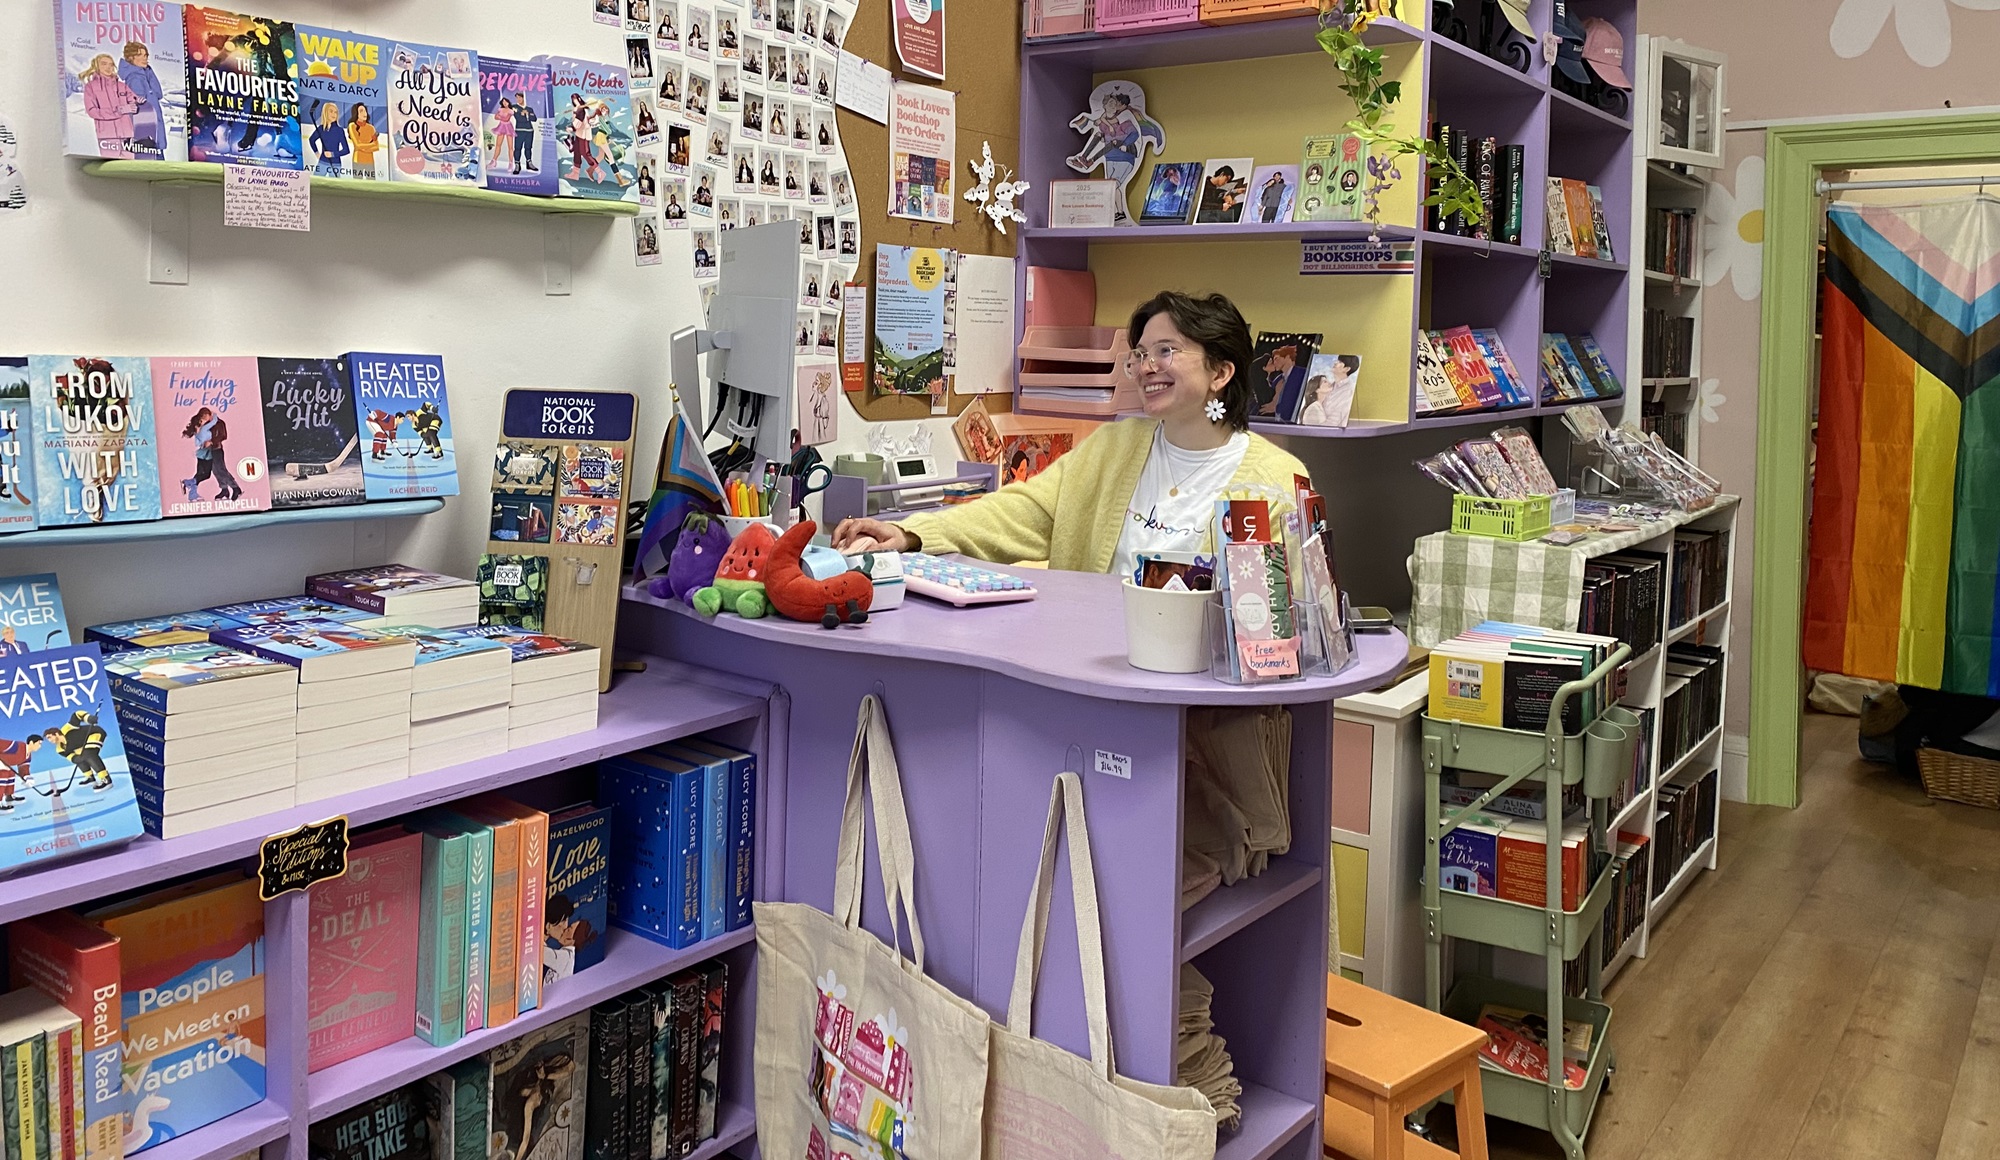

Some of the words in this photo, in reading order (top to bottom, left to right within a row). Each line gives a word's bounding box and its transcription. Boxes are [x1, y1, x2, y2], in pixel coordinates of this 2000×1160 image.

[76, 1, 165, 24] MELTING
[95, 24, 158, 44] POINT
[299, 33, 379, 65] WAKE
[235, 57, 258, 73] THE
[340, 62, 377, 86] UP
[195, 67, 299, 103] FAVOURITES
[299, 78, 324, 91] NAT
[327, 82, 336, 93] &
[339, 84, 379, 98] DARCY
[395, 69, 426, 91] All
[427, 71, 472, 104] You
[478, 72, 549, 93] REVOLVE
[585, 88, 627, 96] RELATIONSHIP
[197, 92, 244, 110] LAYNE
[253, 98, 299, 117] FARGO
[397, 94, 453, 123] Need
[456, 110, 471, 128] is
[896, 94, 919, 110] Book
[921, 99, 950, 116] Lovers
[896, 107, 940, 130] Bookshop
[402, 120, 475, 153] Gloves
[896, 121, 945, 142] Pre-Orders
[100, 140, 119, 150] Cici
[121, 141, 162, 155] Williams
[1481, 141, 1492, 161] KING
[229, 166, 245, 175] THE
[251, 168, 300, 180] FAVOURITES
[326, 166, 376, 178] COCHRANE
[1481, 164, 1492, 177] OF
[247, 177, 268, 186] LAYNE
[270, 179, 289, 187] FARGO
[494, 177, 508, 185] BAL
[510, 178, 541, 187] KHABRA
[878, 252, 889, 261] Shop
[1303, 251, 1393, 263] BOOKSHOPS
[878, 276, 910, 286] Independent.
[358, 361, 440, 382] HEATED
[50, 371, 134, 399] FROM
[169, 371, 237, 397] Finding
[360, 381, 441, 399] RIVALRY
[174, 392, 197, 407] Her
[202, 391, 237, 413] Edge
[266, 380, 345, 411] Lucky
[543, 396, 597, 407] NATIONAL
[45, 404, 142, 434] LUKOV
[286, 403, 331, 431] Hit
[541, 405, 596, 425] BOOK
[541, 422, 595, 435] tokens
[44, 439, 98, 449] MARIANA
[103, 438, 149, 448] ZAPATA
[57, 450, 138, 480] WITH
[580, 465, 604, 474] BOOK
[64, 484, 140, 515] LOVE
[274, 489, 319, 500] HANNAH
[323, 488, 360, 498] COWAN
[389, 487, 418, 495] RACHEL
[420, 486, 438, 494] REID
[168, 500, 212, 514] JENNIFER
[214, 497, 259, 513] IACOPELLI
[496, 571, 519, 580] BOOK
[1264, 559, 1278, 607] SARAH
[354, 594, 368, 605] TOUGH
[368, 599, 380, 608] GUY
[1254, 645, 1275, 656] free
[1250, 656, 1291, 670] bookmarks
[122, 683, 146, 697] COMMON
[146, 691, 160, 703] GOAL
[122, 709, 145, 723] COMMON
[145, 717, 158, 730] GOAL
[121, 734, 144, 749] COMMON
[144, 742, 158, 755] GOAL
[143, 767, 158, 780] GOAL
[1101, 761, 1123, 775] £16.99
[742, 766, 750, 795] LUCY
[143, 792, 157, 804] GOAL
[689, 780, 697, 808] LUCY
[1504, 799, 1533, 810] ALINA
[142, 815, 156, 829] GOAL
[741, 799, 749, 834] SCORE
[1501, 805, 1536, 817] JACOBS
[550, 817, 605, 840] HAZELWOOD
[689, 812, 697, 850] SCORE
[25, 838, 76, 856] RACHEL
[79, 829, 107, 842] REID
[274, 826, 328, 863] Special
[279, 846, 332, 873] Editions
[549, 836, 601, 882] Love
[1456, 850, 1489, 871] Wagon
[281, 874, 289, 885] &
[345, 890, 370, 908] THE
[527, 876, 537, 909] ALLIE
[472, 890, 481, 927] GRACE
[322, 900, 392, 943] DEAL
[524, 925, 534, 955] DEAN
[469, 941, 479, 978] LOGAN
[139, 966, 234, 1015] People
[93, 983, 118, 1048] Beach
[122, 1033, 159, 1060] We
[163, 1014, 221, 1047] Meet
[224, 1003, 250, 1023] on
[308, 1030, 337, 1050] ELLE
[341, 1010, 397, 1039] KENNEDY
[680, 1027, 689, 1065] CROWNS
[95, 1047, 119, 1104] Read
[121, 1036, 251, 1096] Vacation
[22, 1080, 30, 1109] AUSTEN
[98, 1121, 107, 1151] HENRY
[109, 1118, 117, 1146] EMILY
[335, 1116, 370, 1151] HER
[364, 1124, 408, 1160] TAKE
